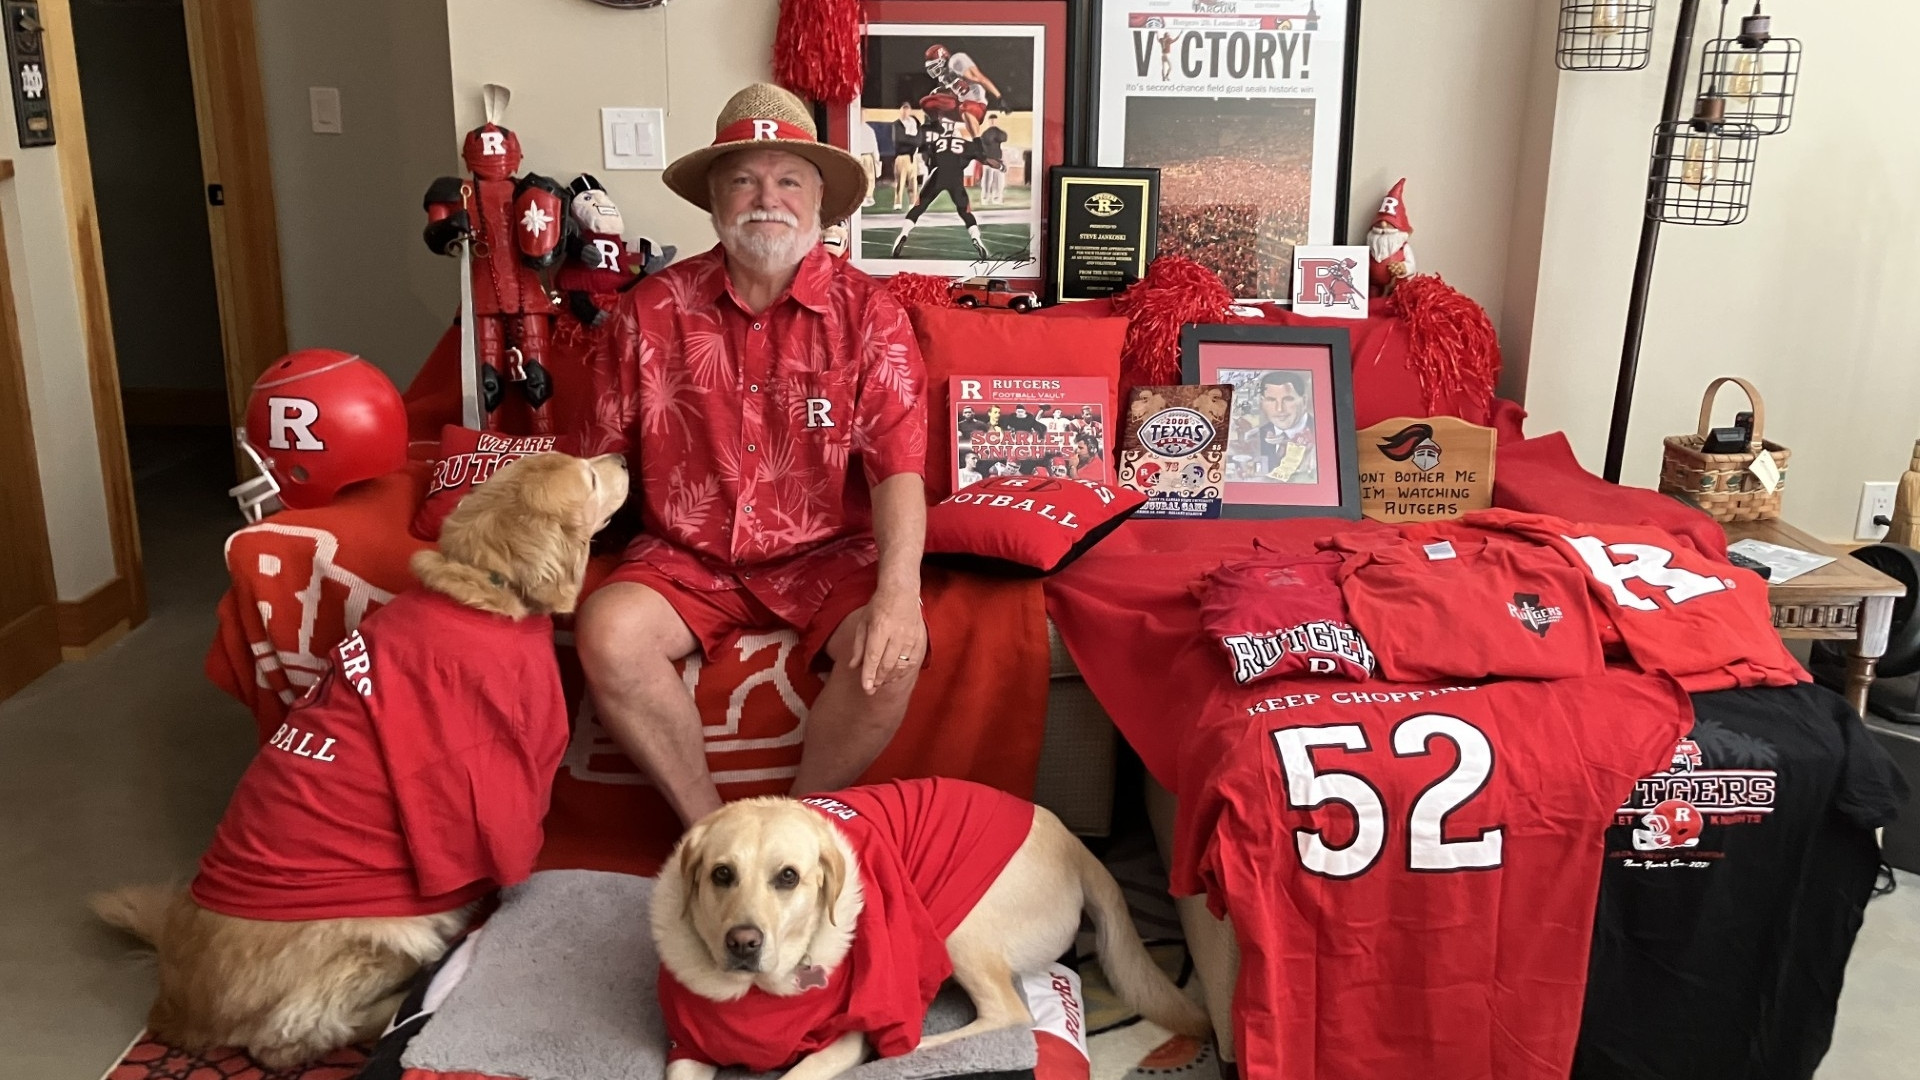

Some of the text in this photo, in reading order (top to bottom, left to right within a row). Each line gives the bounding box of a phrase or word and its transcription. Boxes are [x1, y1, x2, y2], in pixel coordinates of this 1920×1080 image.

[1145, 84, 1205, 92] second-chance
[1207, 84, 1225, 92] field
[1226, 86, 1244, 94] goal
[1268, 86, 1298, 94] historic
[752, 119, 779, 142] R
[480, 131, 507, 156] R
[936, 139, 966, 154] 35
[1098, 199, 1112, 211] R
[1379, 196, 1399, 215] R
[593, 239, 621, 273] R
[961, 380, 983, 400] R
[993, 379, 1061, 390] RUTGERS
[806, 398, 835, 427] R
[267, 396, 325, 451] R
[972, 432, 1074, 446] SCARLET
[1151, 424, 1204, 442] TEXAS
[478, 434, 556, 453] WE ARE
[972, 447, 1075, 460] KNIGHTS
[1359, 471, 1476, 483] ON'T BOTHER ME
[1363, 486, 1470, 499] I'M WATCHING
[1385, 501, 1458, 514] RUTGERS
[1246, 694, 1321, 716] KEEP
[1271, 711, 1505, 881] 52
[1622, 777, 1778, 806] TGERS
[1674, 808, 1691, 821] R
